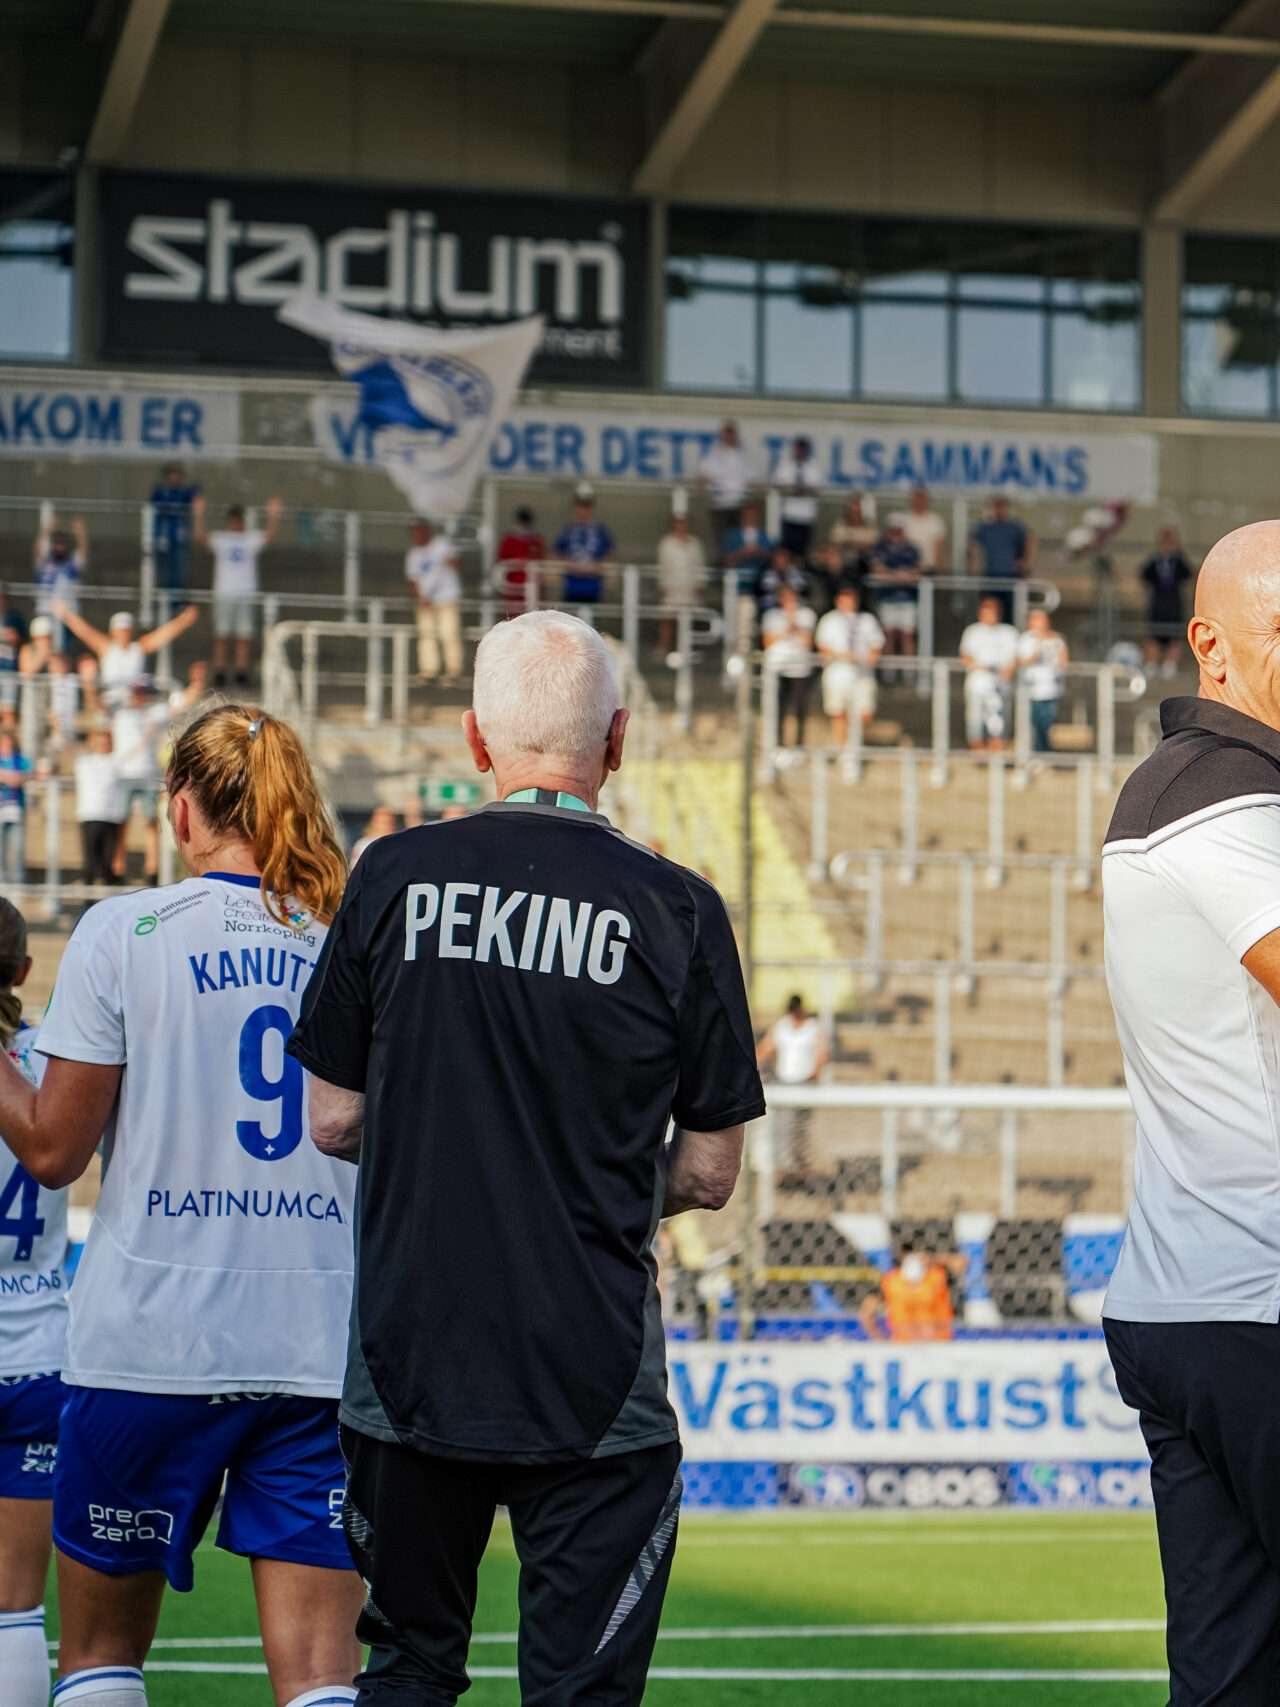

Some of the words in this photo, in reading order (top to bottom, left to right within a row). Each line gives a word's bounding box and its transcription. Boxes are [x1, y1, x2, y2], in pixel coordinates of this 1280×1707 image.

[124, 200, 624, 322] stadium
[0, 393, 123, 445] KOM
[140, 397, 205, 450] ER
[224, 920, 316, 948] Norrköping
[404, 882, 632, 985] PEKING
[189, 947, 317, 994] KANUT
[236, 1005, 303, 1162] 9
[147, 1189, 347, 1226] PLATINUMCA
[88, 1503, 133, 1524] pre
[90, 1523, 156, 1543] zero
